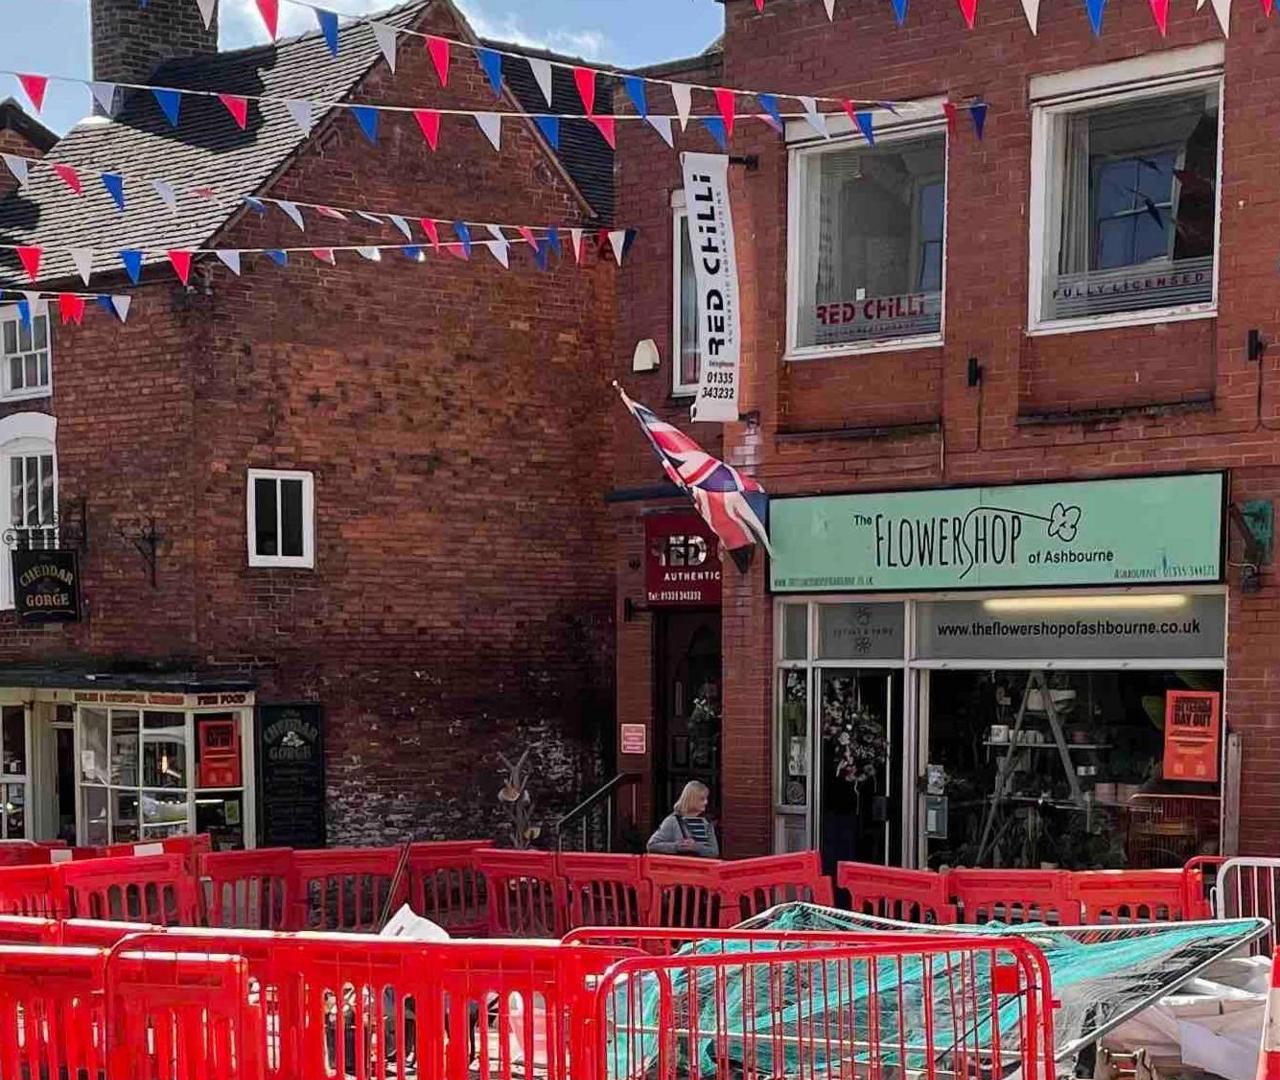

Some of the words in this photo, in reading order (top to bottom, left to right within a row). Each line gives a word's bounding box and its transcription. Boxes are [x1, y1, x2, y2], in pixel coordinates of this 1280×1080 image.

[1113, 273, 1204, 293] LICENSED
[816, 302, 855, 325] RED
[706, 288, 725, 356] RED
[707, 371, 734, 384] 01335
[702, 386, 735, 400] 343232
[853, 514, 872, 526] The
[1028, 551, 1041, 564] of
[1044, 549, 1114, 564] Ashbourne
[20, 564, 74, 587] CHEDDAR
[664, 571, 721, 582] AUTHENTIC
[26, 592, 70, 607] GORGE
[938, 618, 1200, 639] www.theflowershopofashbourne.co.uk
